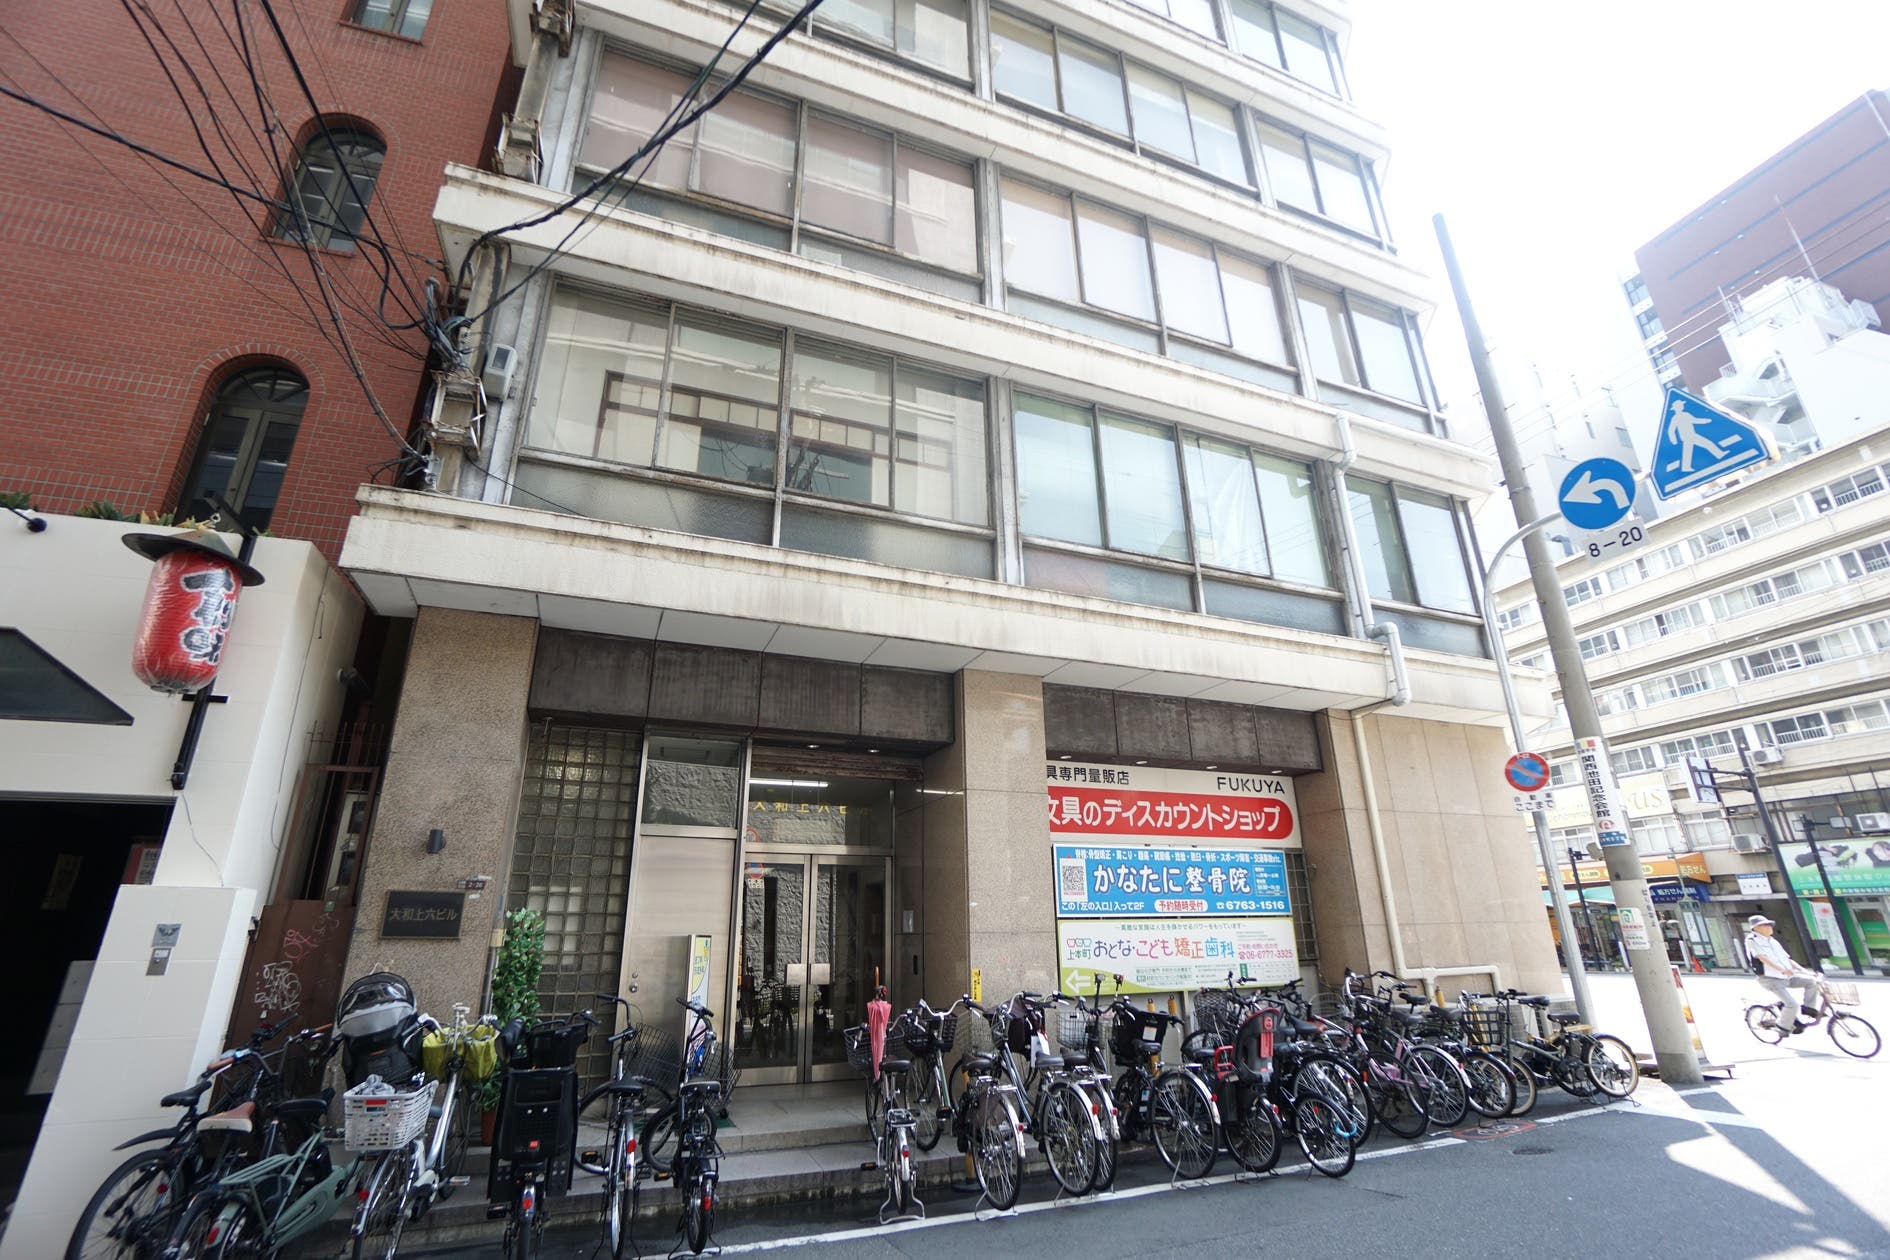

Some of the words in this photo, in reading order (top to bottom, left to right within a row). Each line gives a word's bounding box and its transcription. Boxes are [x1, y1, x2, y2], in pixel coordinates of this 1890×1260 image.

[1216, 776, 1285, 794] FUKUYA
[1515, 799, 1554, 812] ここまで
[1093, 864, 1251, 895] かなたに整骨院
[390, 907, 458, 921] 大和上六ビル
[1067, 949, 1092, 960] 上本町
